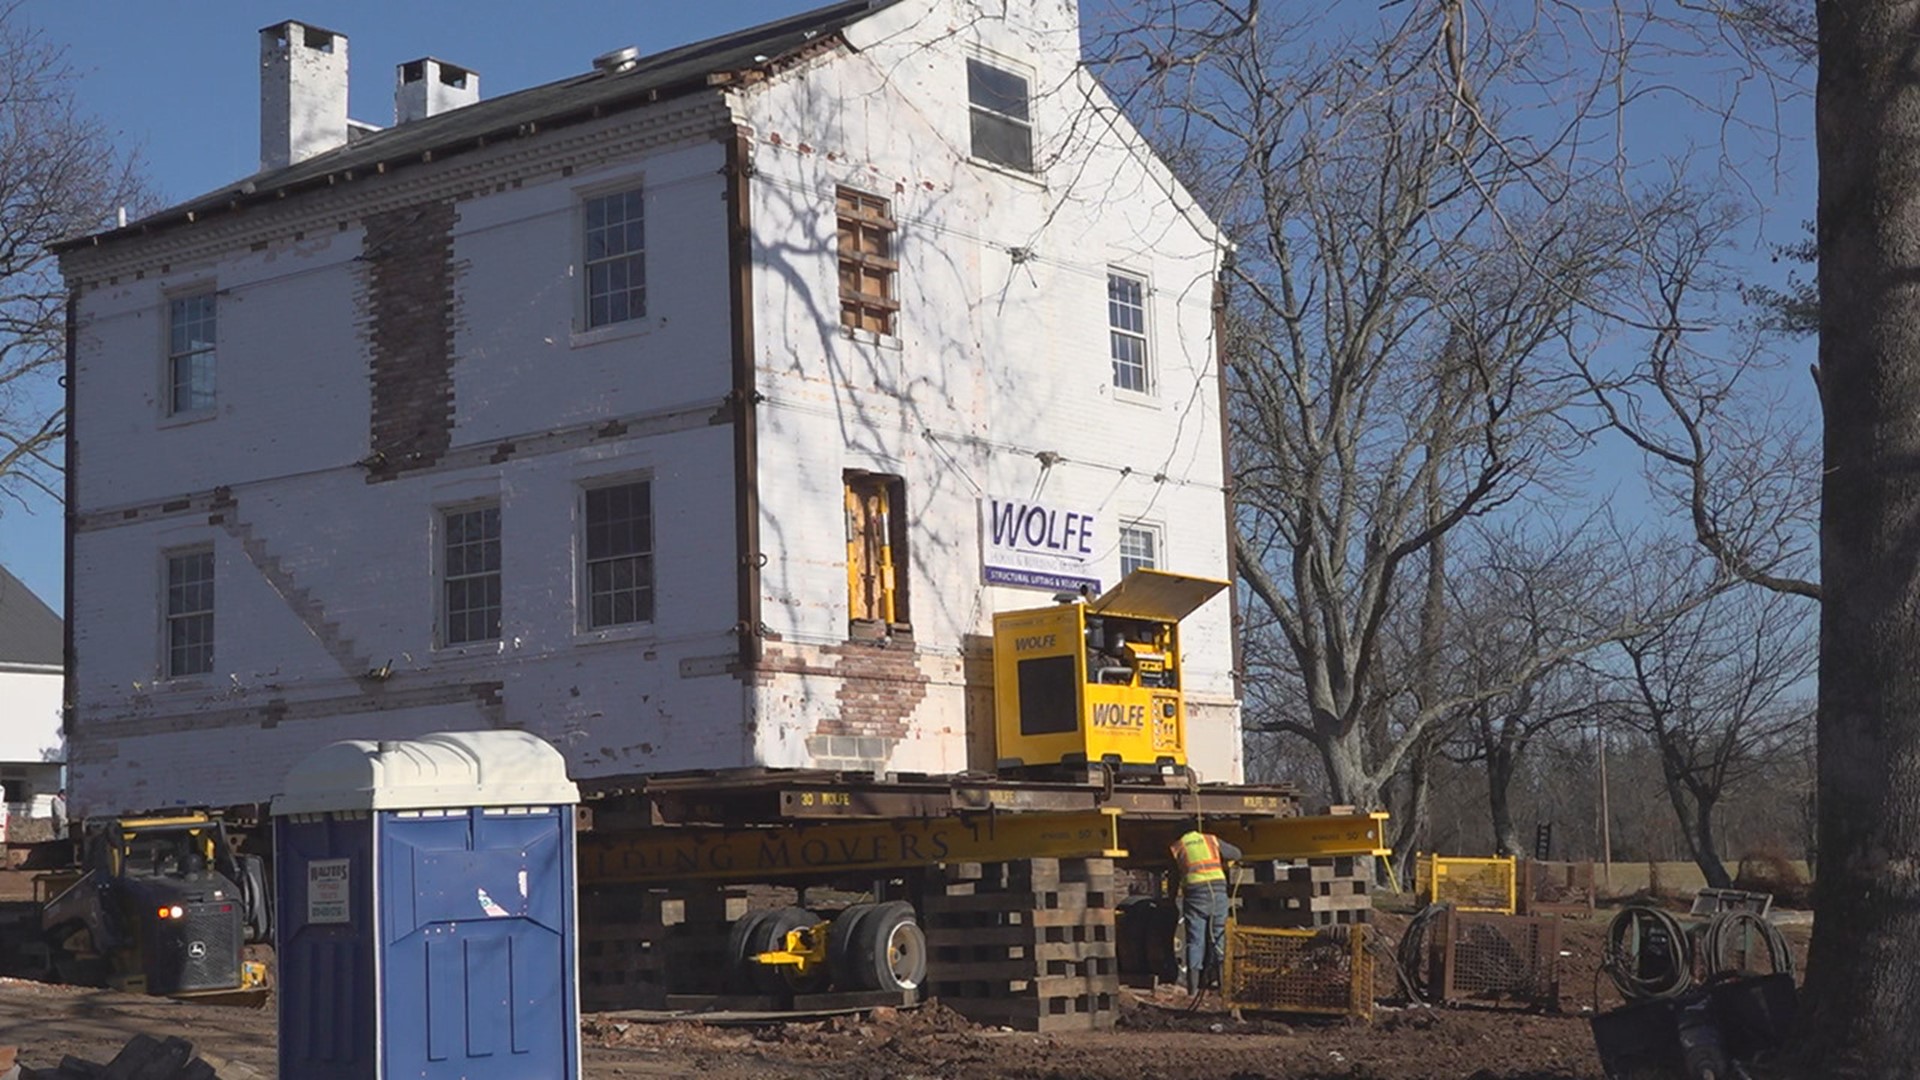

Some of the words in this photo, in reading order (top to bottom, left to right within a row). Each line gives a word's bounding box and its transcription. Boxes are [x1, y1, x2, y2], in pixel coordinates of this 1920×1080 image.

[991, 500, 1094, 554] WOLFE
[1015, 634, 1057, 651] WOLFE
[1092, 702, 1145, 727] WOLFE
[800, 792, 814, 806] 30
[821, 792, 851, 806] WOLFE
[757, 830, 949, 869] MOVERS
